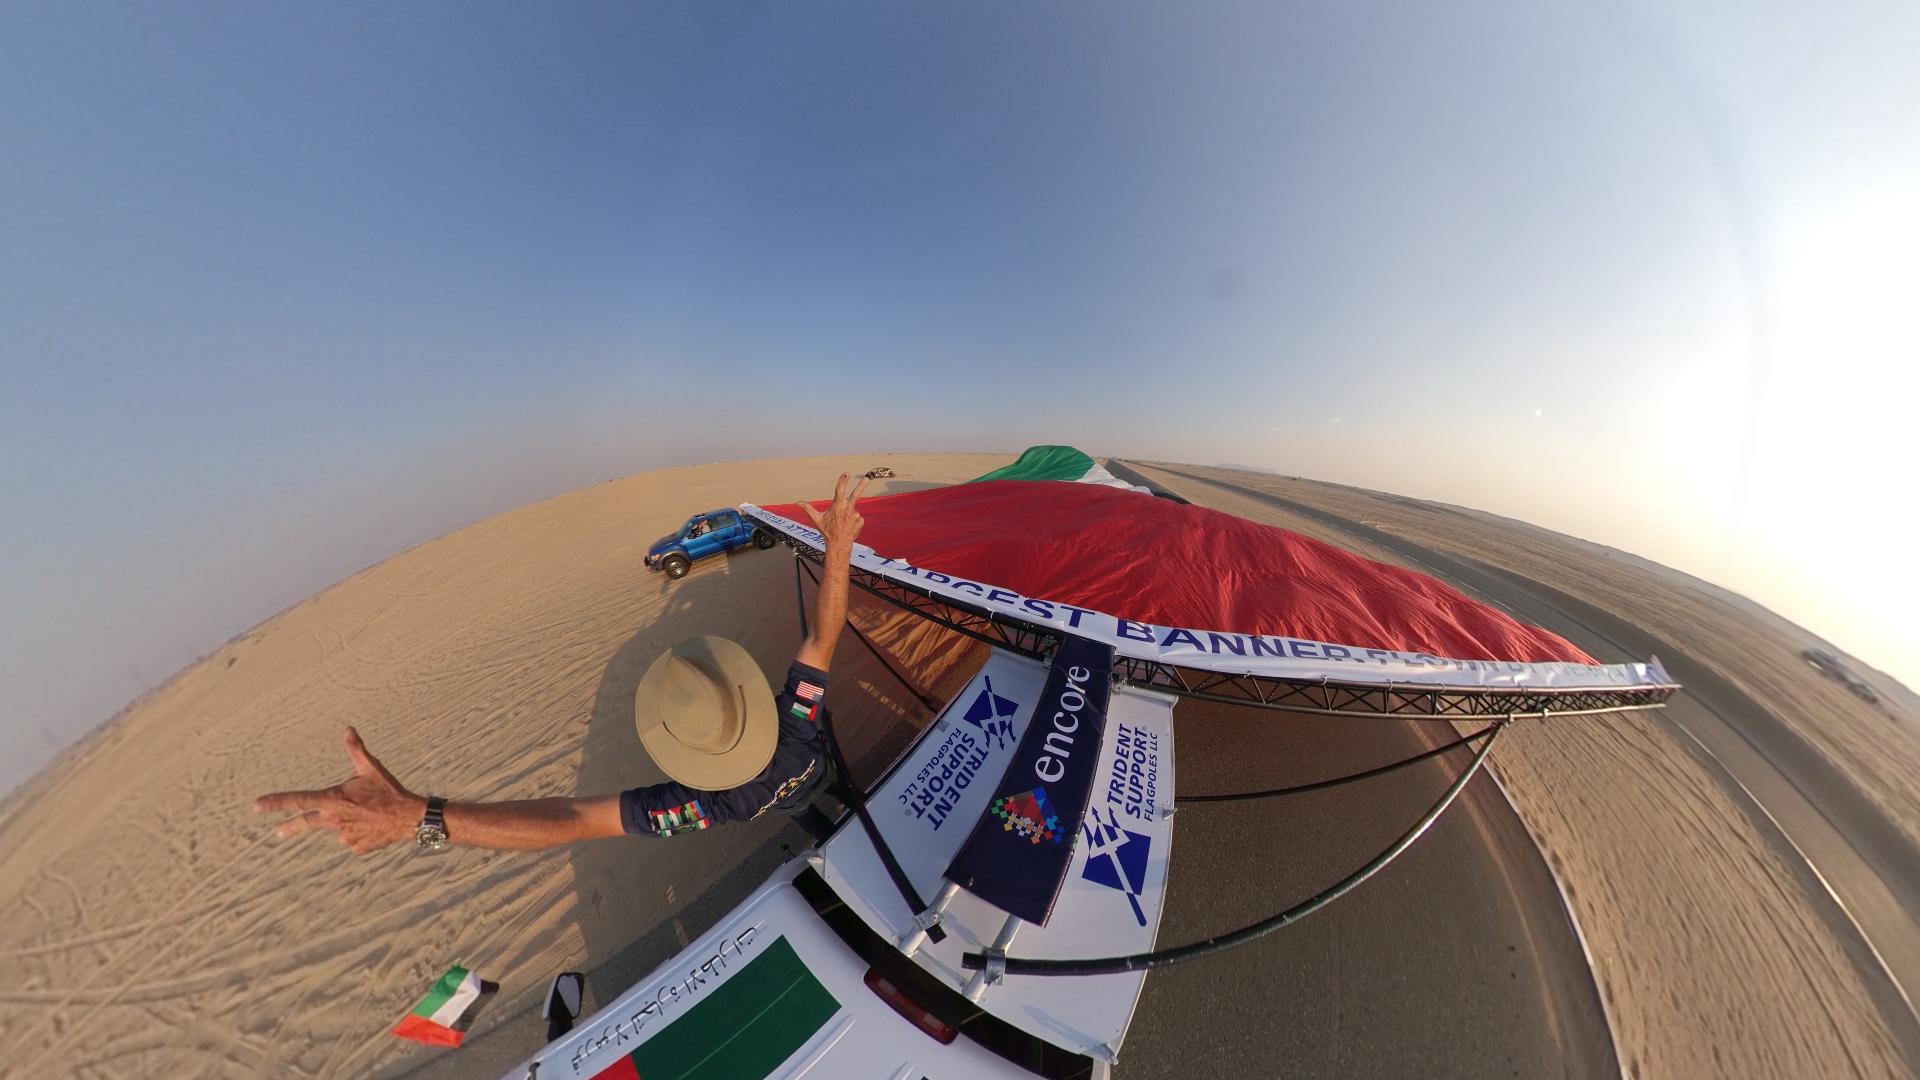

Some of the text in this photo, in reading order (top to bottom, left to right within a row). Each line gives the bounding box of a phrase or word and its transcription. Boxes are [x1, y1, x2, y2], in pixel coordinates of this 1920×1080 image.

[786, 524, 825, 545] ATTEM
[1116, 619, 1365, 664] BANNER
[898, 727, 962, 805] FLAGPOLES LLC
[1034, 665, 1090, 783] encore
[1106, 723, 1132, 805] TRIDENT
[910, 733, 975, 819] SUPPORT
[927, 747, 989, 831] TRIDENT
[1125, 726, 1148, 820] SUPPORT
[1143, 732, 1158, 822] FLAGPOLES LLC
